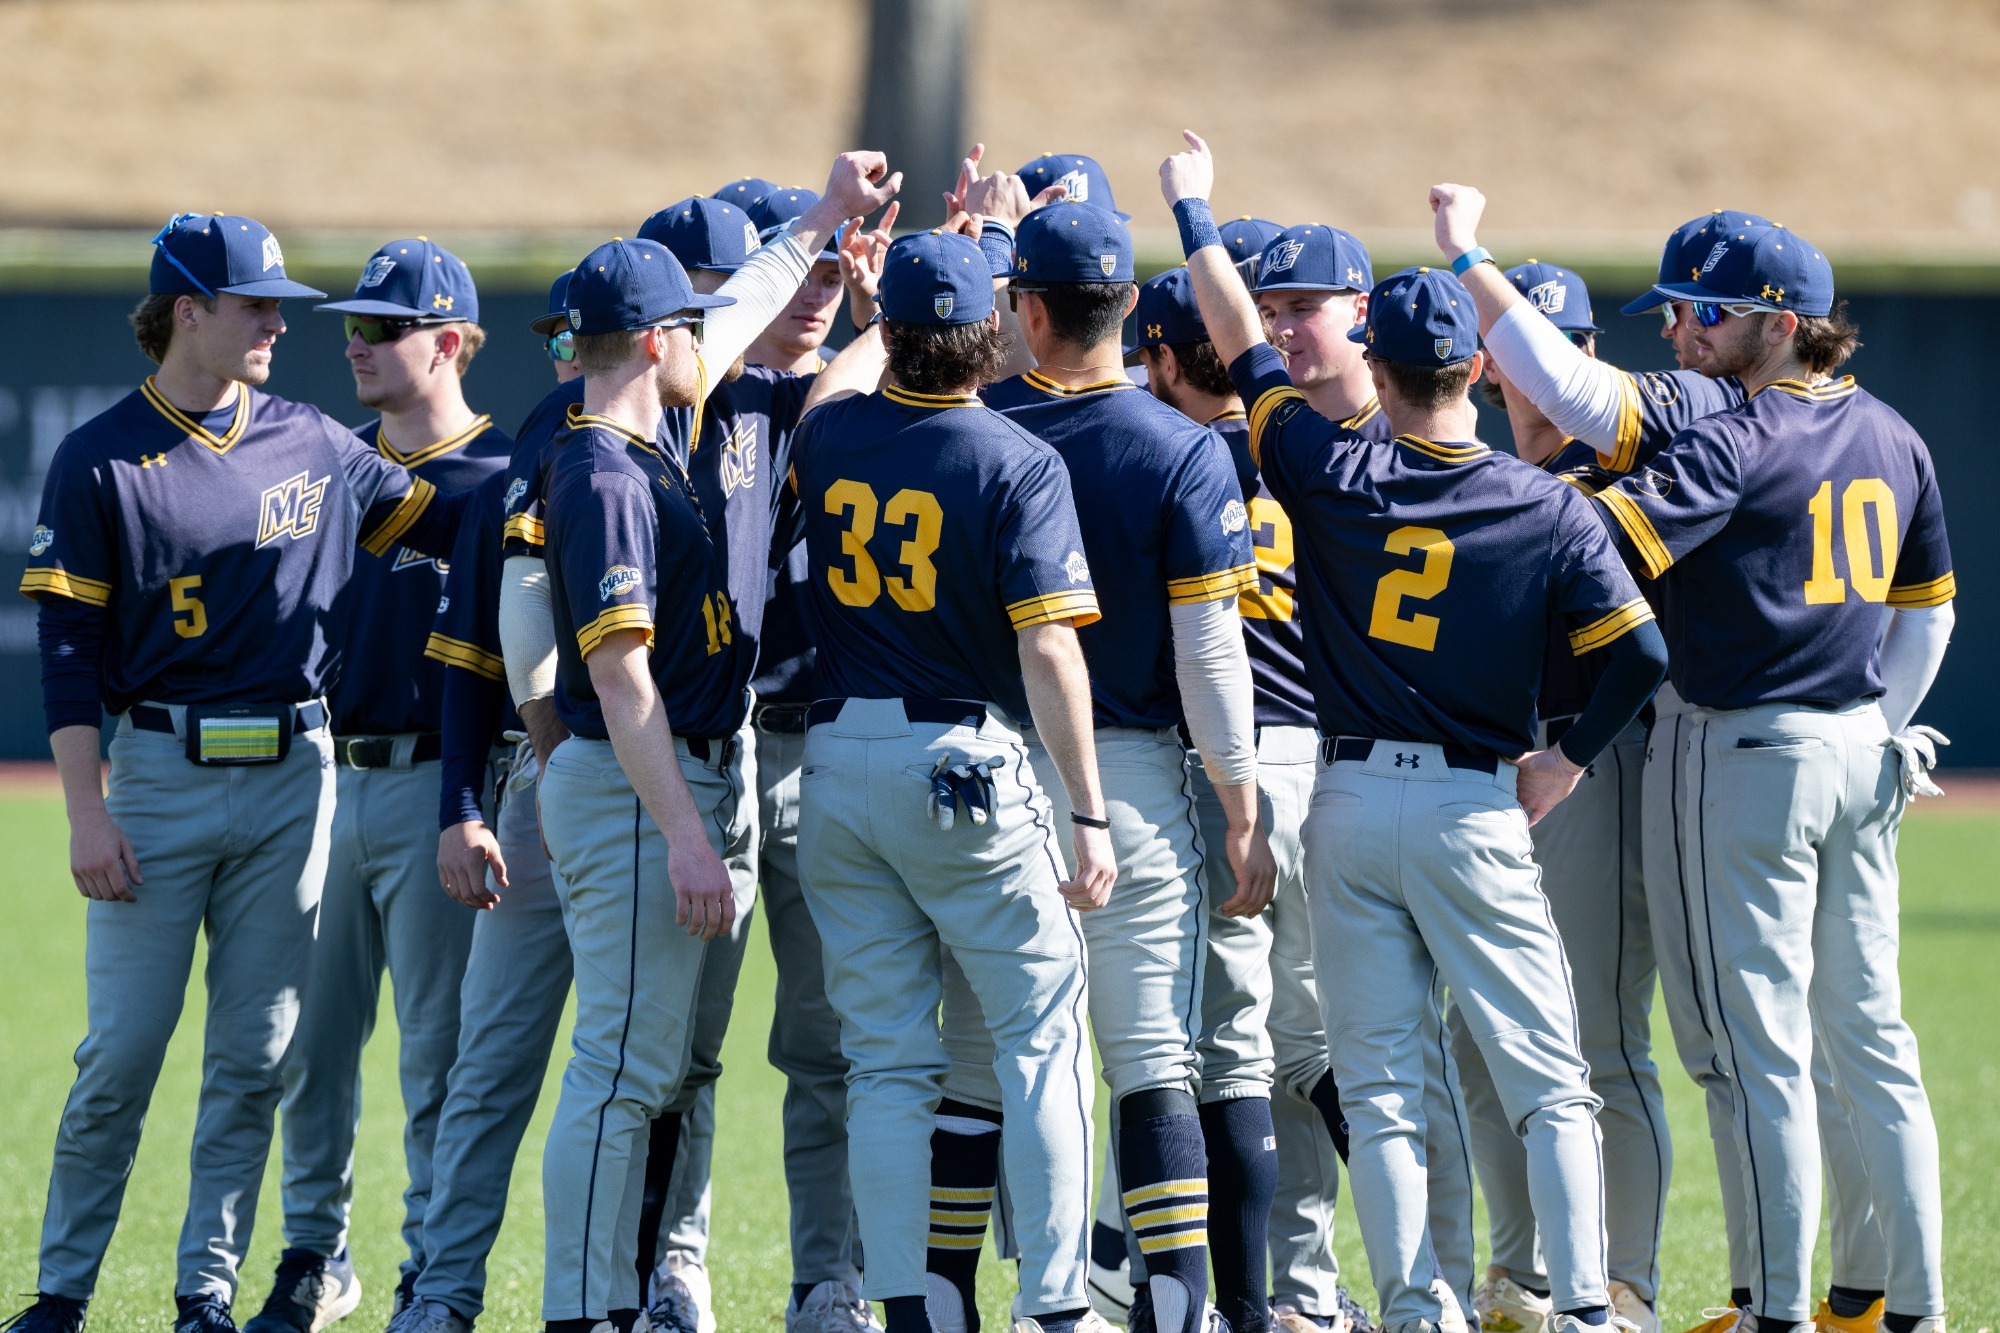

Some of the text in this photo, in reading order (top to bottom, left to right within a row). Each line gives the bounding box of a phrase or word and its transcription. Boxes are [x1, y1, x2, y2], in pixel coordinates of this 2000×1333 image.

[1260, 239, 1304, 281] MC
[1528, 280, 1566, 314] MC
[255, 470, 331, 551] MC
[825, 478, 944, 612] 33
[1804, 478, 1898, 605] 10
[169, 574, 208, 638] 5
[600, 569, 641, 600] MAAC
[1368, 526, 1455, 651] 2
